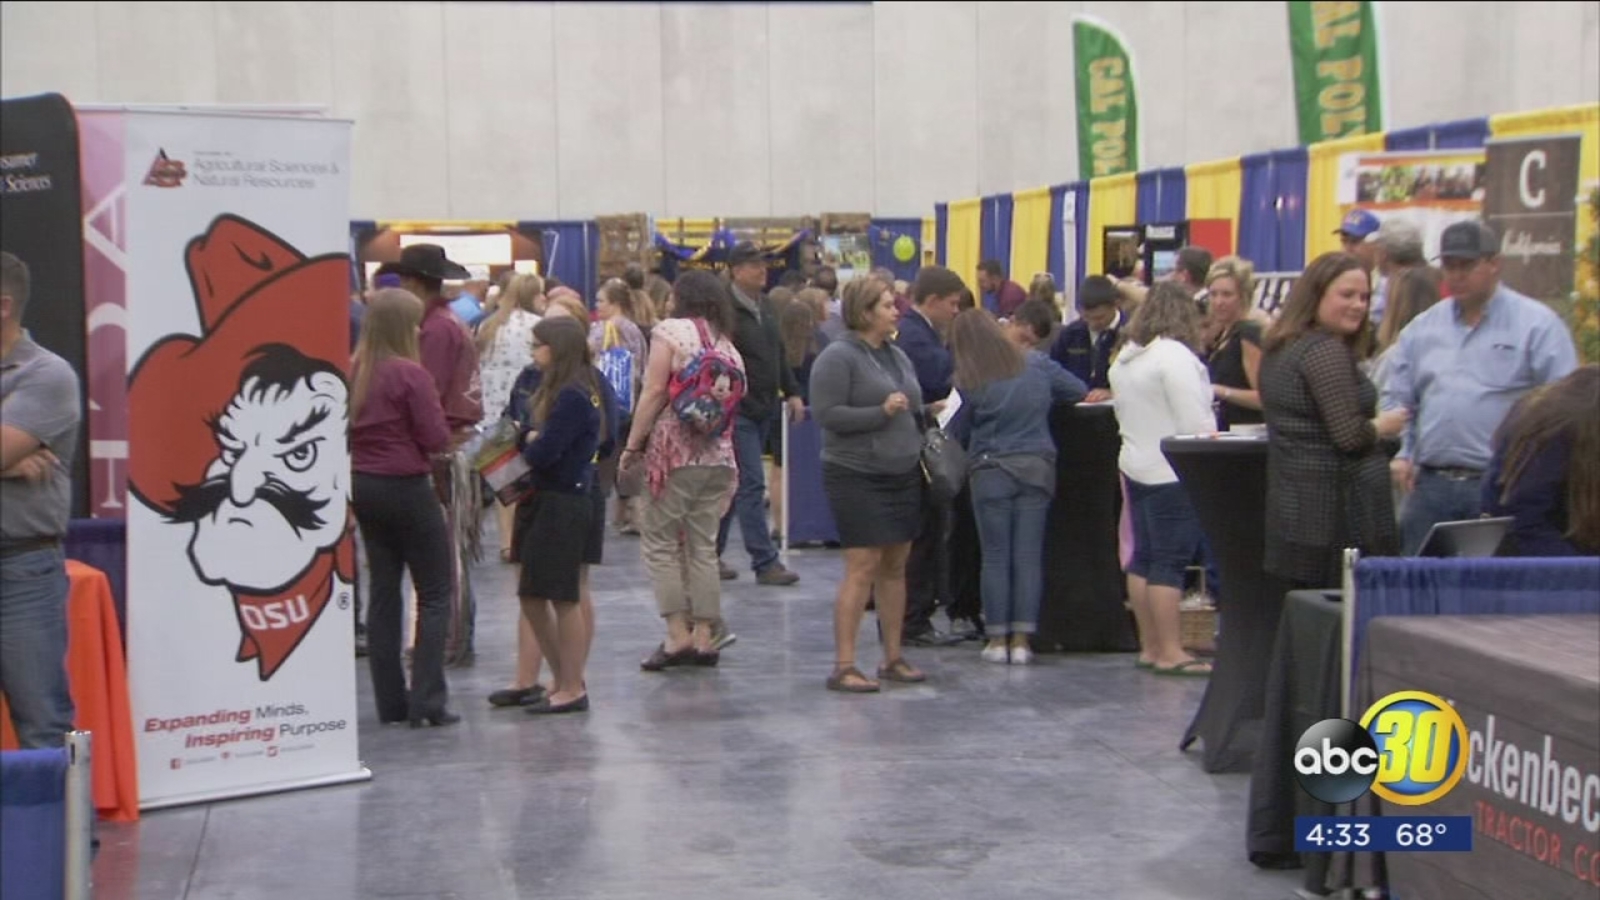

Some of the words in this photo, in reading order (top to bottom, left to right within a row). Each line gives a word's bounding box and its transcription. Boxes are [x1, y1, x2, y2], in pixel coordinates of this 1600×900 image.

[1089, 57, 1126, 114] CAL
[1520, 150, 1546, 209] C
[240, 595, 309, 630] OSU
[144, 708, 251, 733] Expanding
[185, 726, 276, 749] Inspiring
[279, 718, 347, 737] Purpose
[1463, 715, 1600, 832] ckenbec
[1476, 800, 1562, 868] TRACTOR
